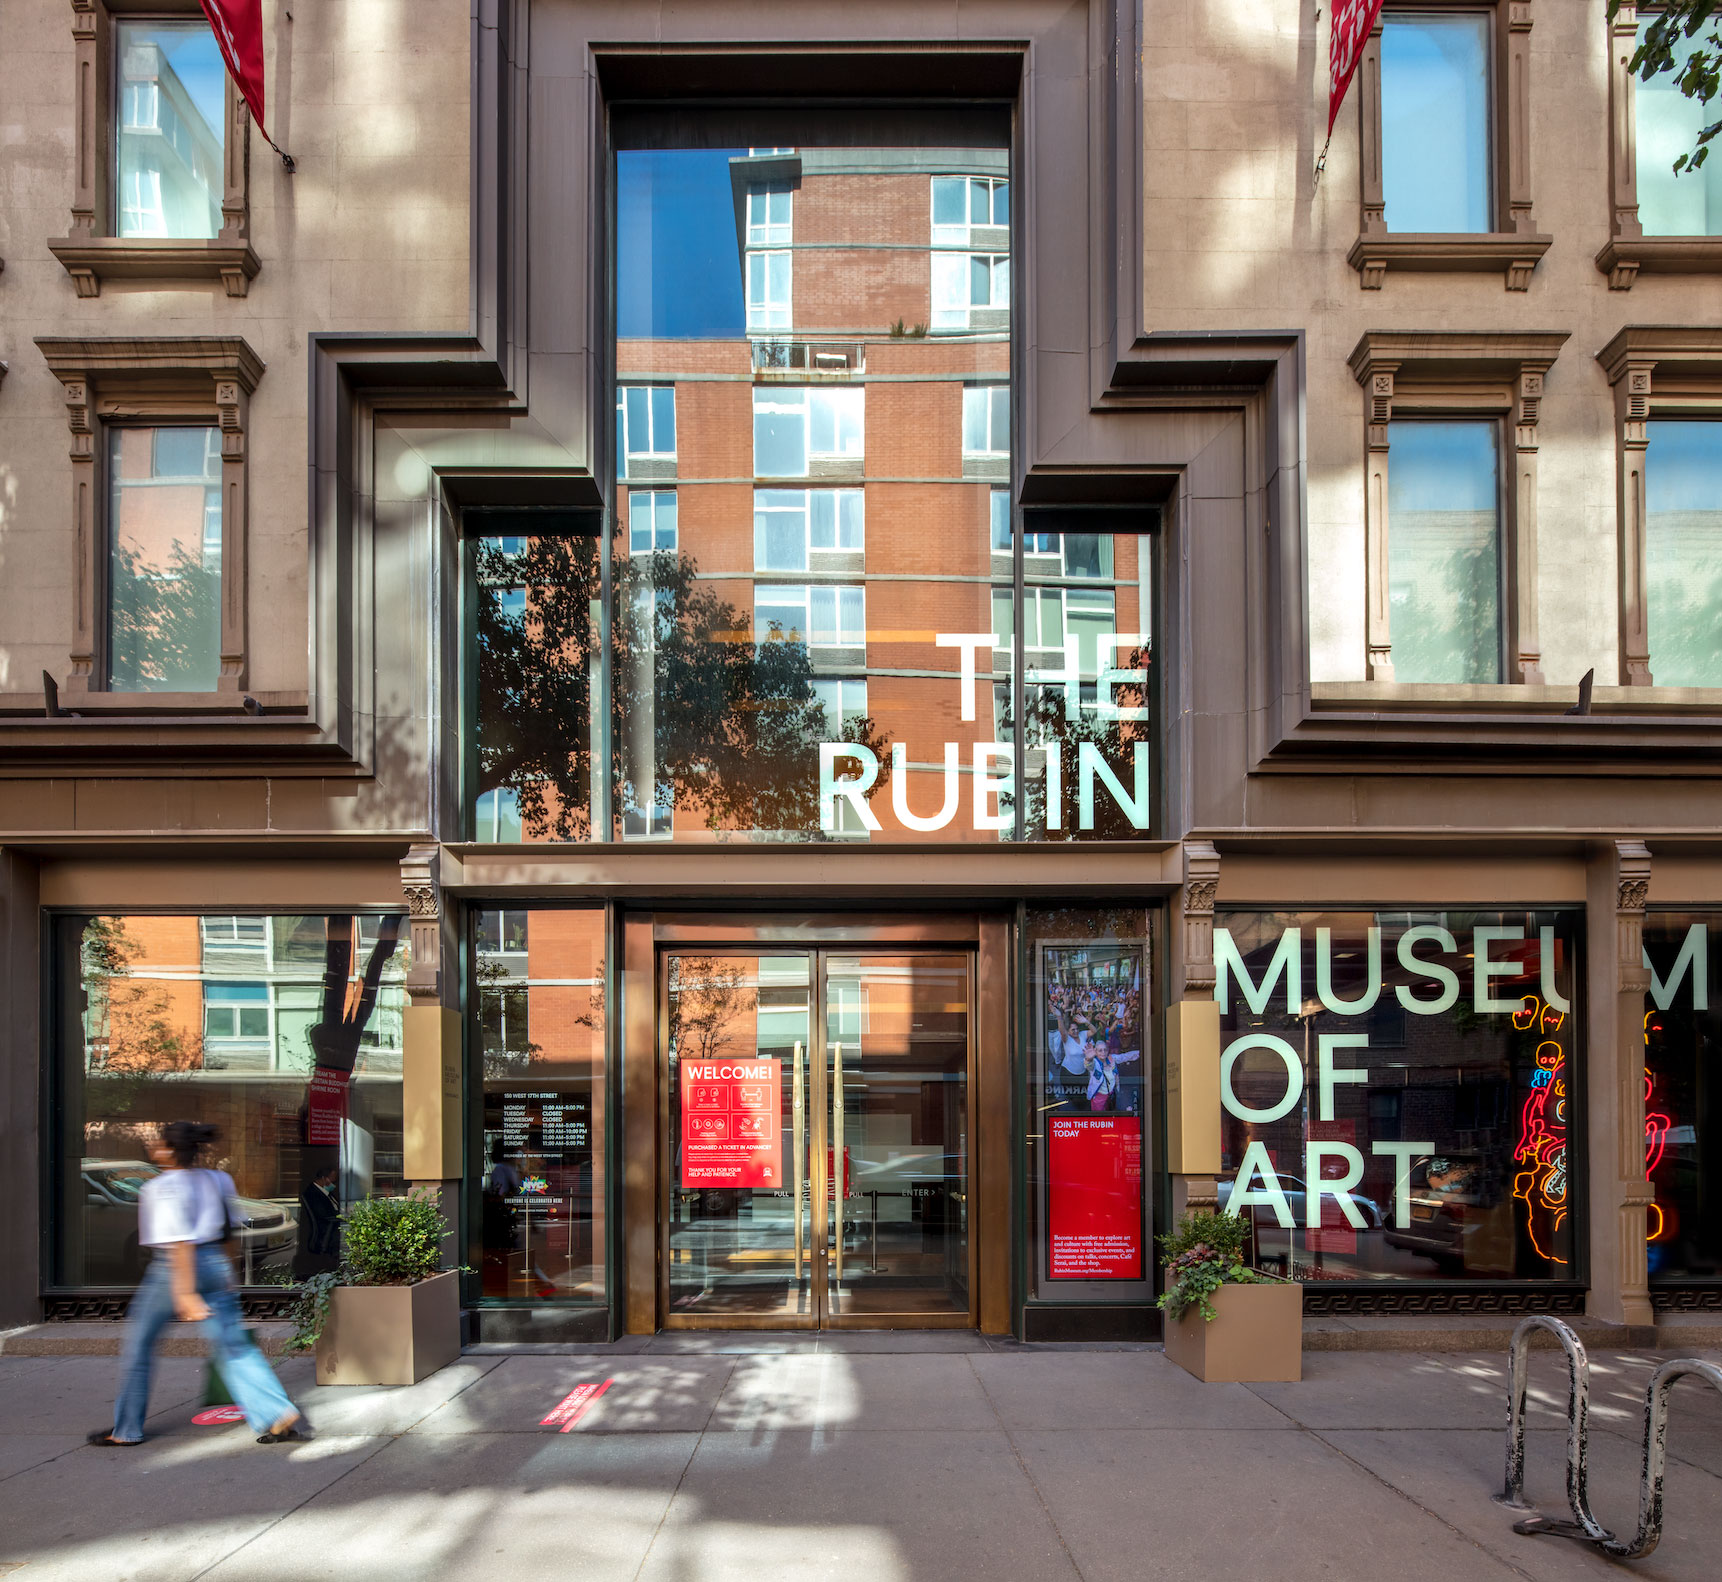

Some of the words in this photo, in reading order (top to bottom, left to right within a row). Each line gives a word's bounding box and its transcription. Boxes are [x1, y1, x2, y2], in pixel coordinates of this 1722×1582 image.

[936, 633, 1150, 722] THE
[819, 742, 1150, 832] RUBIN
[688, 1066, 772, 1079] WELCOME!
[1220, 1033, 1370, 1123] OF
[1226, 1141, 1436, 1229] ART
